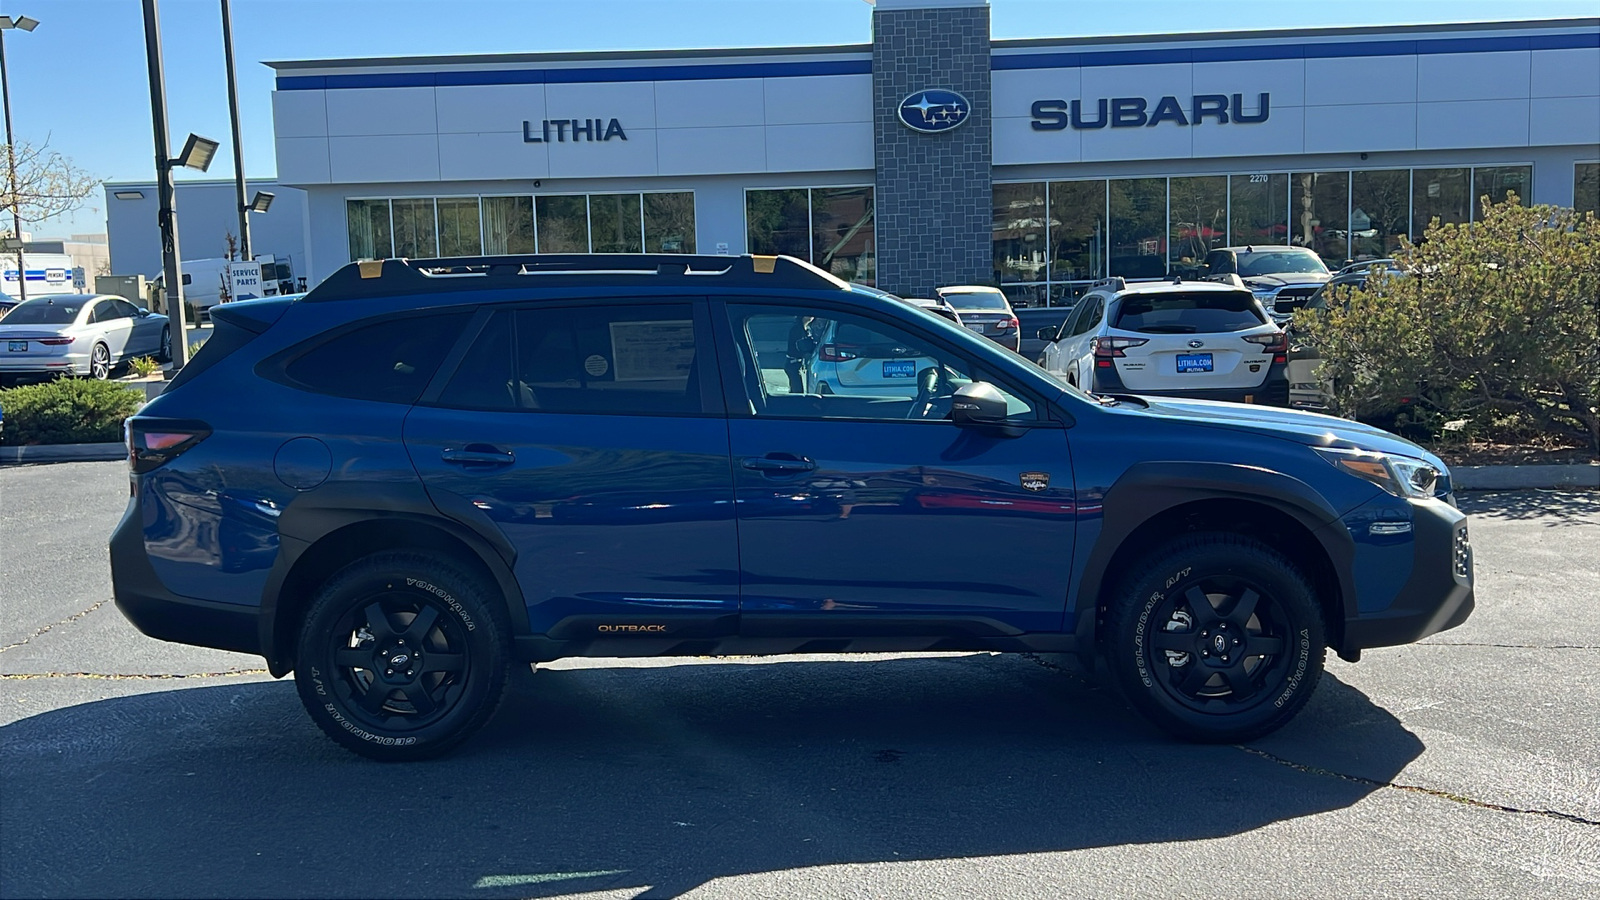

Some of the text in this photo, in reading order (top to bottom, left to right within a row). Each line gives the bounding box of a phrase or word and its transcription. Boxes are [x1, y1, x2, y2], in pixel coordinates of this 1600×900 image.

[1031, 92, 1270, 131] SUBARU
[522, 118, 628, 143] LITHIA
[1249, 174, 1269, 183] 2270
[232, 268, 259, 277] SERVICE
[236, 278, 257, 286] PARTS
[1178, 359, 1212, 367] LITHIA.COM
[406, 577, 476, 632] YOKOHAMA
[598, 624, 667, 632] OUTBACK
[1135, 566, 1192, 688] GEOLANDAR A/T
[1273, 628, 1310, 708] YOKOHAMA
[311, 666, 417, 746] GEOLANDAR A/T
